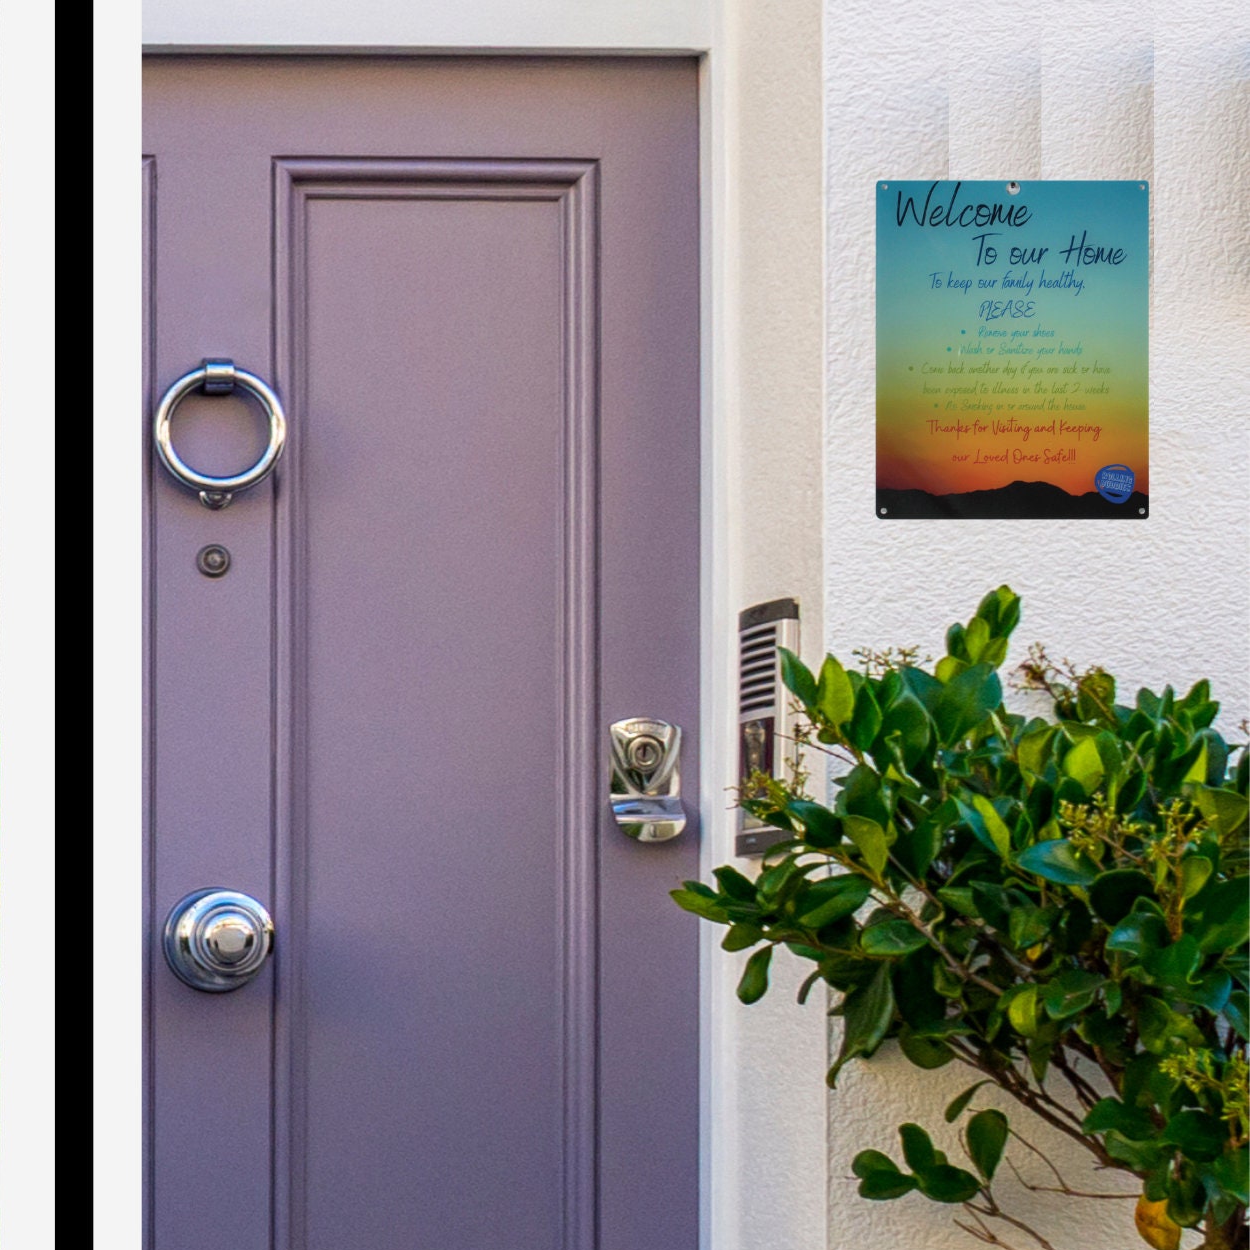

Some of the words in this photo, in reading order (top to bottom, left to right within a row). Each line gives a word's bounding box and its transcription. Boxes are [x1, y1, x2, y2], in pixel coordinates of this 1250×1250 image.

[897, 181, 1033, 227] Welcome
[973, 233, 1002, 267] To
[1010, 247, 1049, 265] our
[1060, 231, 1128, 265] Home
[930, 272, 944, 289] To
[947, 271, 972, 294] keep
[979, 280, 998, 289] our
[1002, 271, 1034, 296] family
[980, 300, 1036, 320] PLEASE
[978, 326, 1008, 338] Remove
[1011, 330, 1030, 342] your
[1033, 323, 1055, 338] shoes
[961, 341, 982, 354] Wash
[999, 341, 1034, 354] Sanitize
[1038, 347, 1055, 360] your
[1059, 341, 1082, 354] hands
[922, 362, 944, 374] Come
[948, 361, 965, 373] back
[969, 361, 1000, 374] another
[1003, 361, 1017, 378] day
[1029, 367, 1043, 378] you
[1064, 362, 1077, 374] sick
[1093, 360, 1112, 374] have
[923, 382, 942, 394] been
[945, 382, 978, 397] exposed
[981, 384, 990, 394] to
[993, 382, 1019, 394] illness
[1023, 384, 1031, 394] in
[1035, 382, 1049, 394] the
[1052, 382, 1069, 394] last
[1071, 382, 1081, 394] 2
[1085, 382, 1110, 394] weeks
[1048, 400, 1060, 410] the
[1064, 399, 1086, 410] house
[927, 418, 971, 441] Thanks
[973, 420, 989, 434] for
[993, 418, 1032, 442] Visiting
[1035, 419, 1055, 435] and
[1060, 419, 1103, 442] Keeping
[952, 454, 970, 462] our
[973, 449, 1009, 465] Loved
[1014, 450, 1040, 463] Ones
